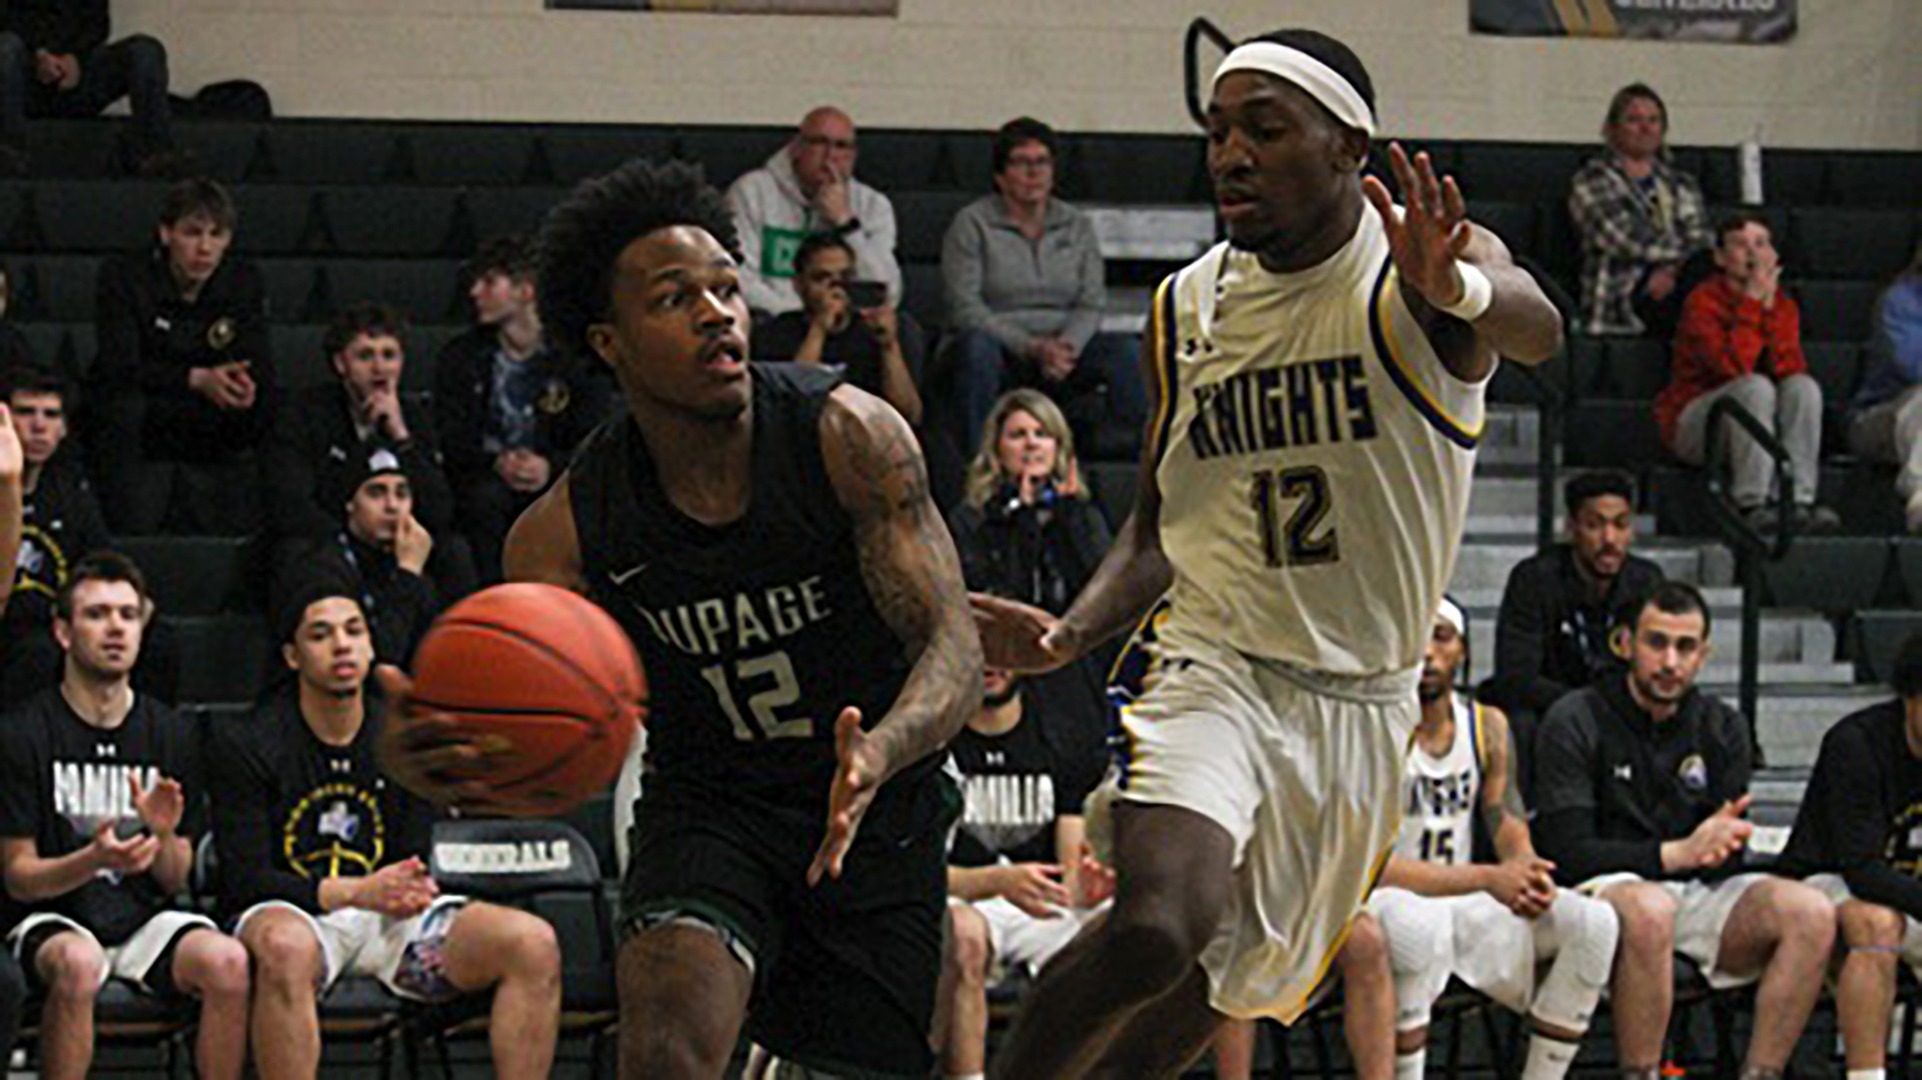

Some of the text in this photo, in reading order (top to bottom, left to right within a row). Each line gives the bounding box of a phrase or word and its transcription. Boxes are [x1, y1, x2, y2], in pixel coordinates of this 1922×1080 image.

[1188, 355, 1377, 460] KNIGHTS
[1251, 465, 1339, 568] 12
[701, 650, 813, 740] 12
[964, 774, 1054, 825] AMILIA
